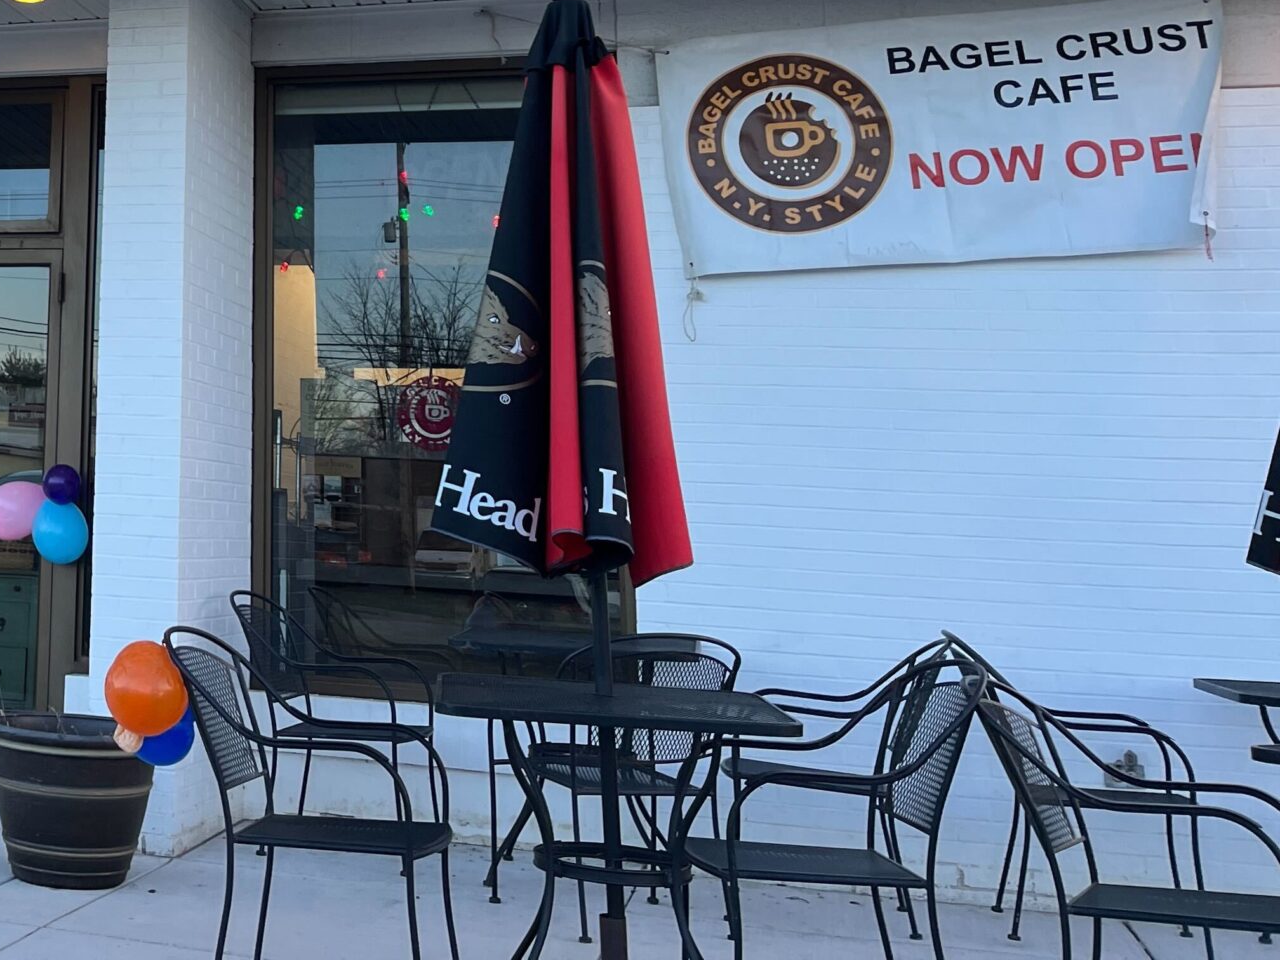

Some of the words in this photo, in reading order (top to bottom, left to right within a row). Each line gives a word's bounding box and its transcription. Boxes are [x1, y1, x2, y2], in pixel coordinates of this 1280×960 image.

[886, 40, 1042, 75] BAGEL
[1055, 20, 1214, 60] CRUST
[698, 85, 742, 154] BAGEL
[741, 63, 830, 87] CRUST
[832, 80, 880, 139] CAFE
[993, 72, 1119, 108] CAFE
[713, 178, 772, 222] N.Y.
[784, 163, 877, 224] STYLE
[908, 144, 1045, 191] NOW
[434, 464, 542, 543] Head
